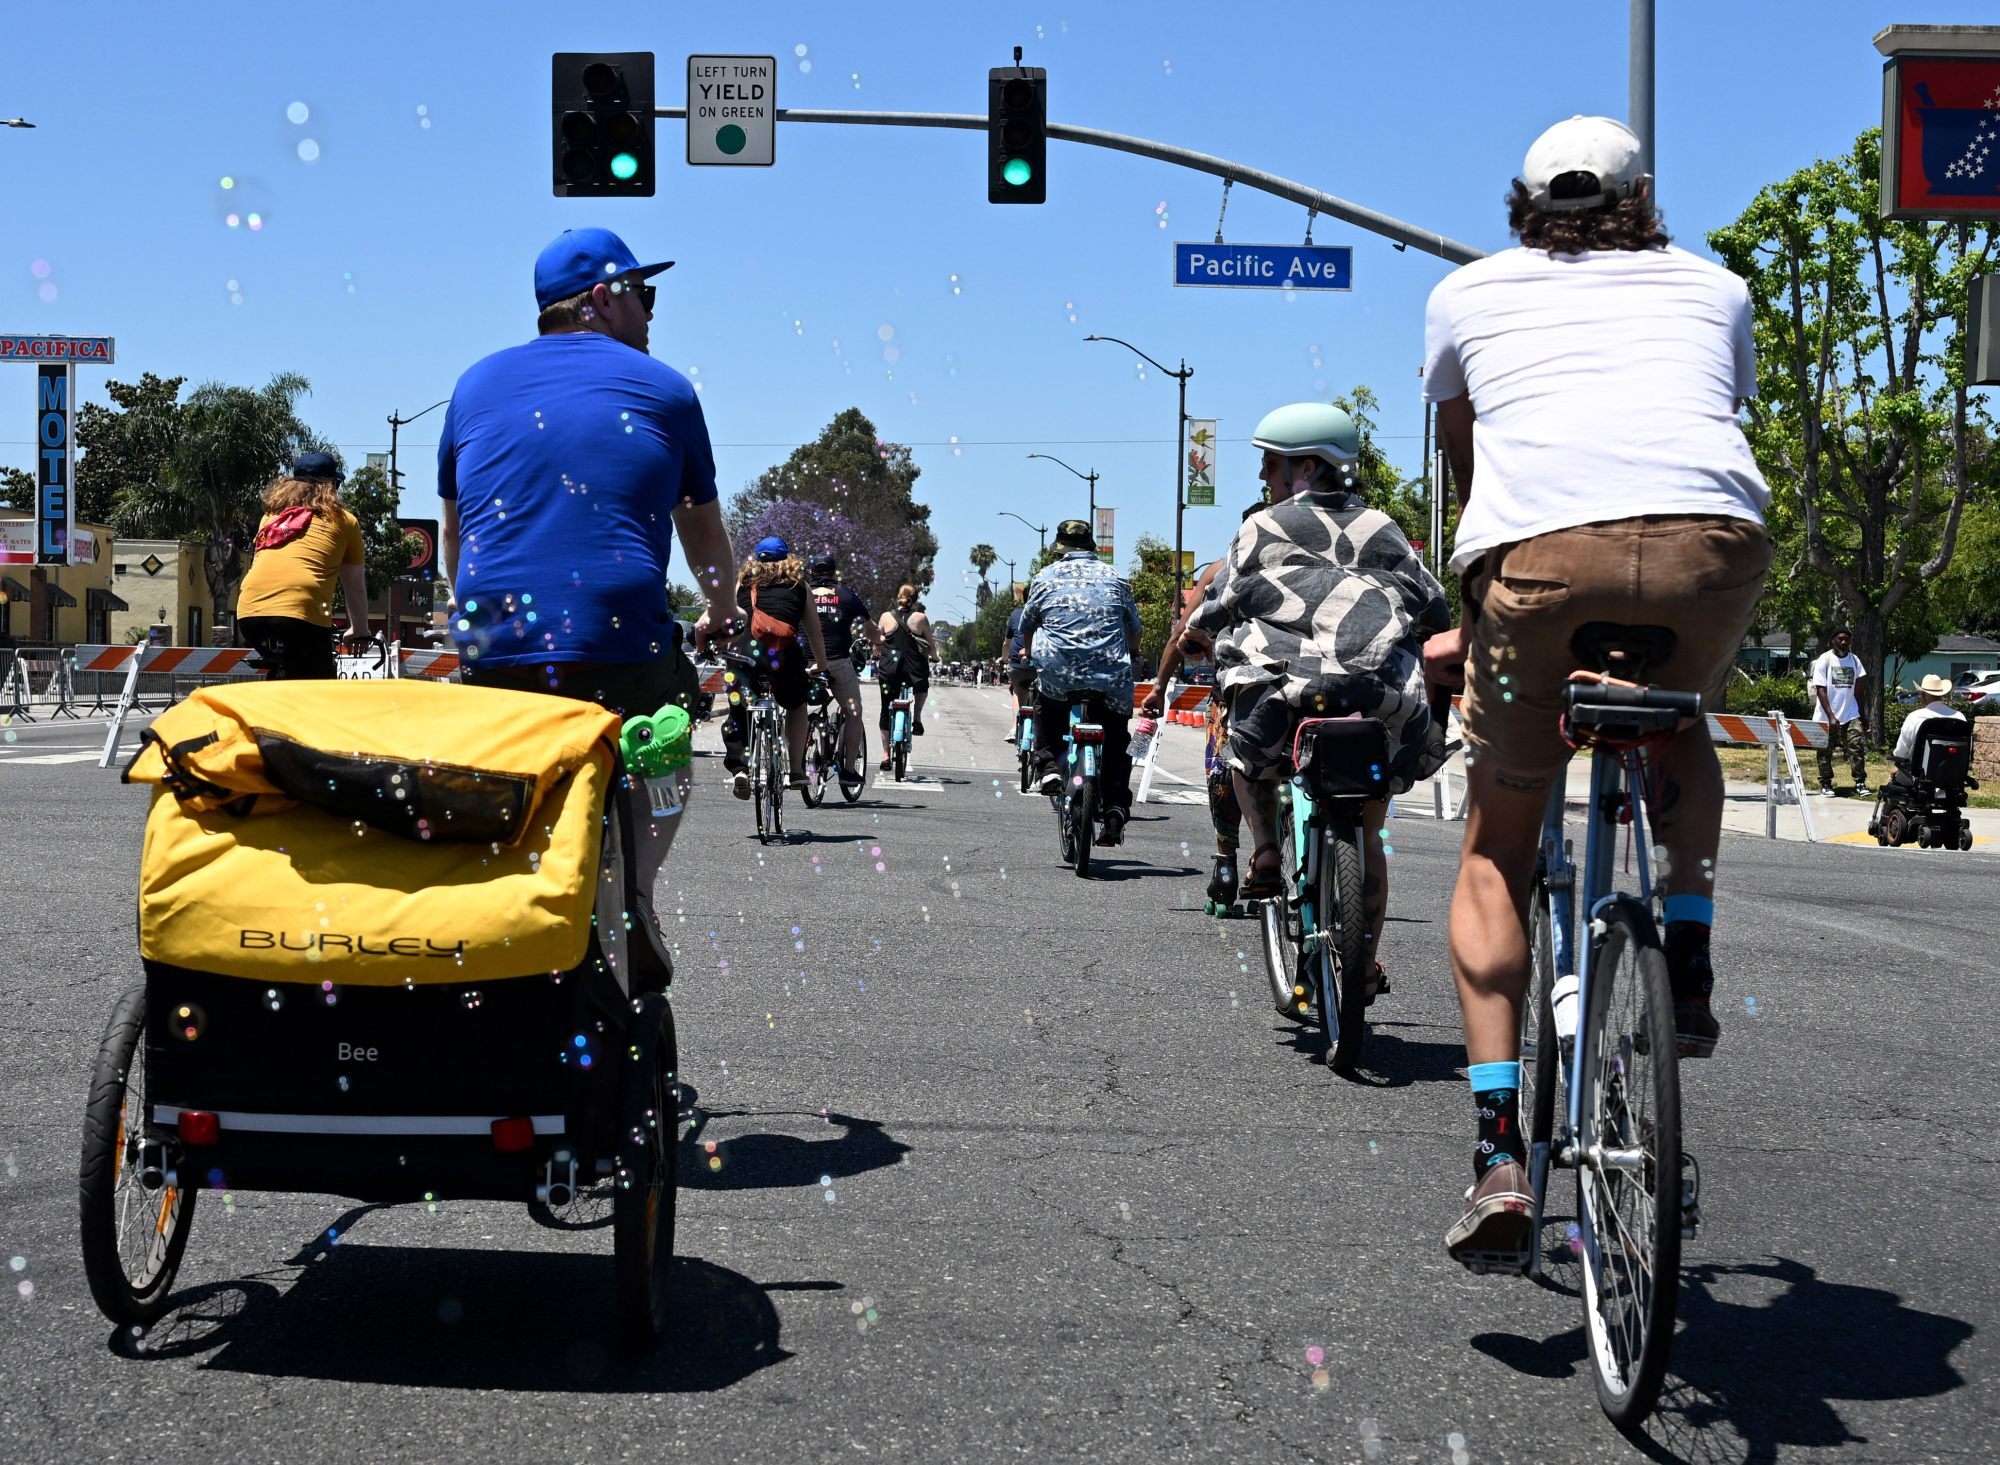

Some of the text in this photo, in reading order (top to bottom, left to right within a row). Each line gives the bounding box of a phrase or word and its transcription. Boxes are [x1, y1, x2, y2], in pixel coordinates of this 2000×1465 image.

[696, 66, 767, 78] LEFT TURN
[699, 84, 764, 100] YIELD
[698, 106, 764, 118] ON GREEN
[1190, 254, 1336, 279] Pacific Ave
[0, 340, 107, 358] PACIFICA
[39, 376, 67, 554] MOTEL
[821, 596, 839, 604] Bull
[239, 929, 465, 958] BURLEY
[338, 1042, 379, 1062] Bee
